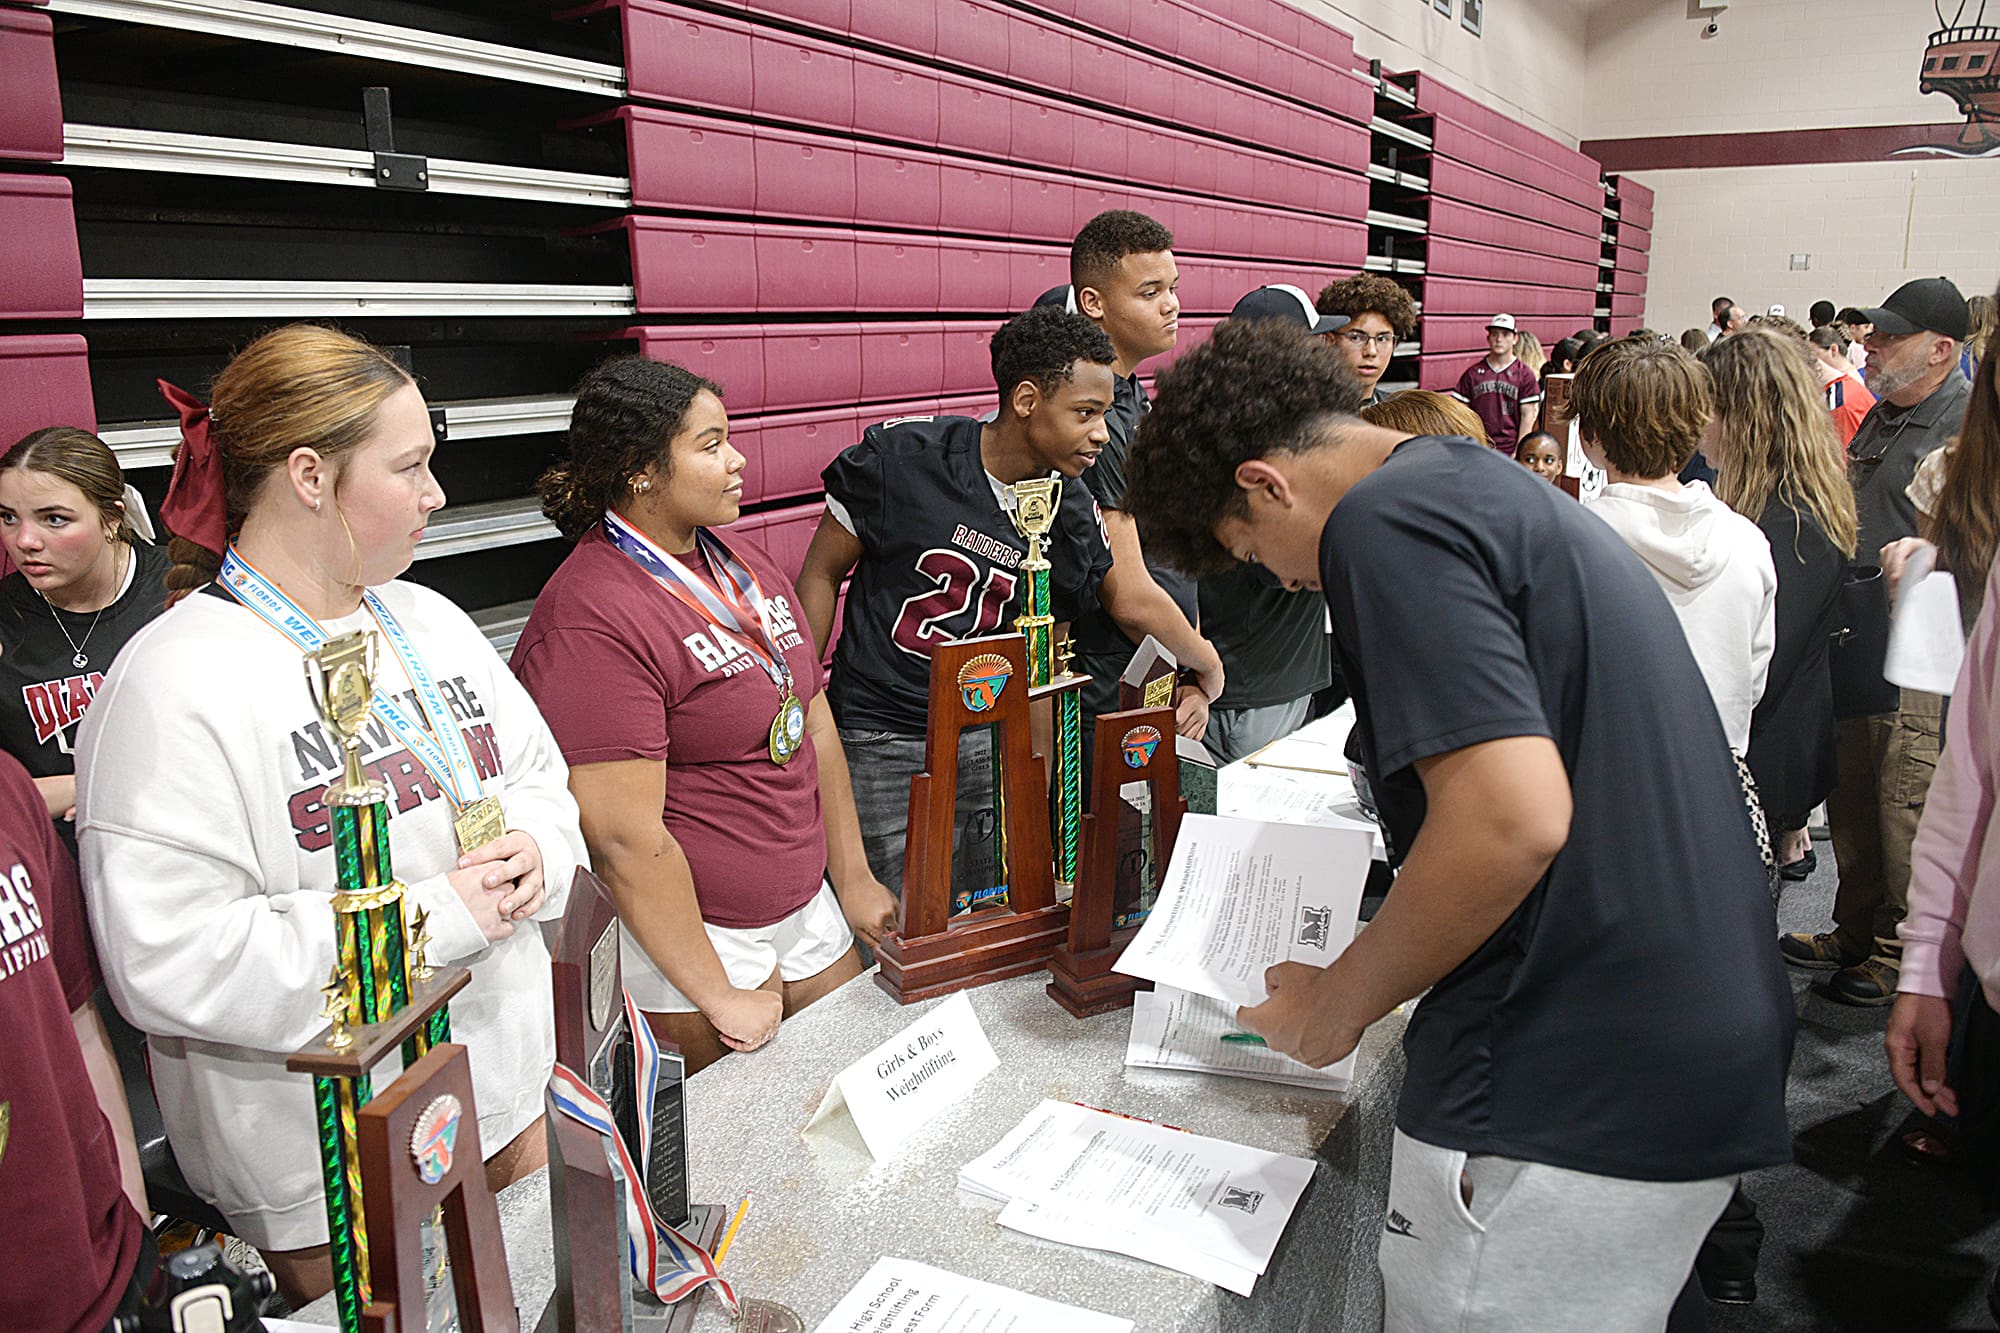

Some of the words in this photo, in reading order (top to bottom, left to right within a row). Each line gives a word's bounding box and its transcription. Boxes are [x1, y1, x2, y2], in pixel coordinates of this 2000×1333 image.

[951, 523, 1022, 569] RAIDERS
[247, 583, 283, 613] FLORIDA
[891, 548, 1018, 659] 21
[364, 594, 443, 716] WEIGHTLIFTING
[973, 884, 1009, 900] FLORIDA
[877, 1053, 906, 1080] Girls
[906, 1043, 918, 1060] &
[917, 1027, 945, 1051] Boys
[886, 1049, 956, 1102] Weightlifting
[849, 1309, 876, 1331] High
[868, 1277, 902, 1309] School
[914, 1294, 940, 1318] Form
